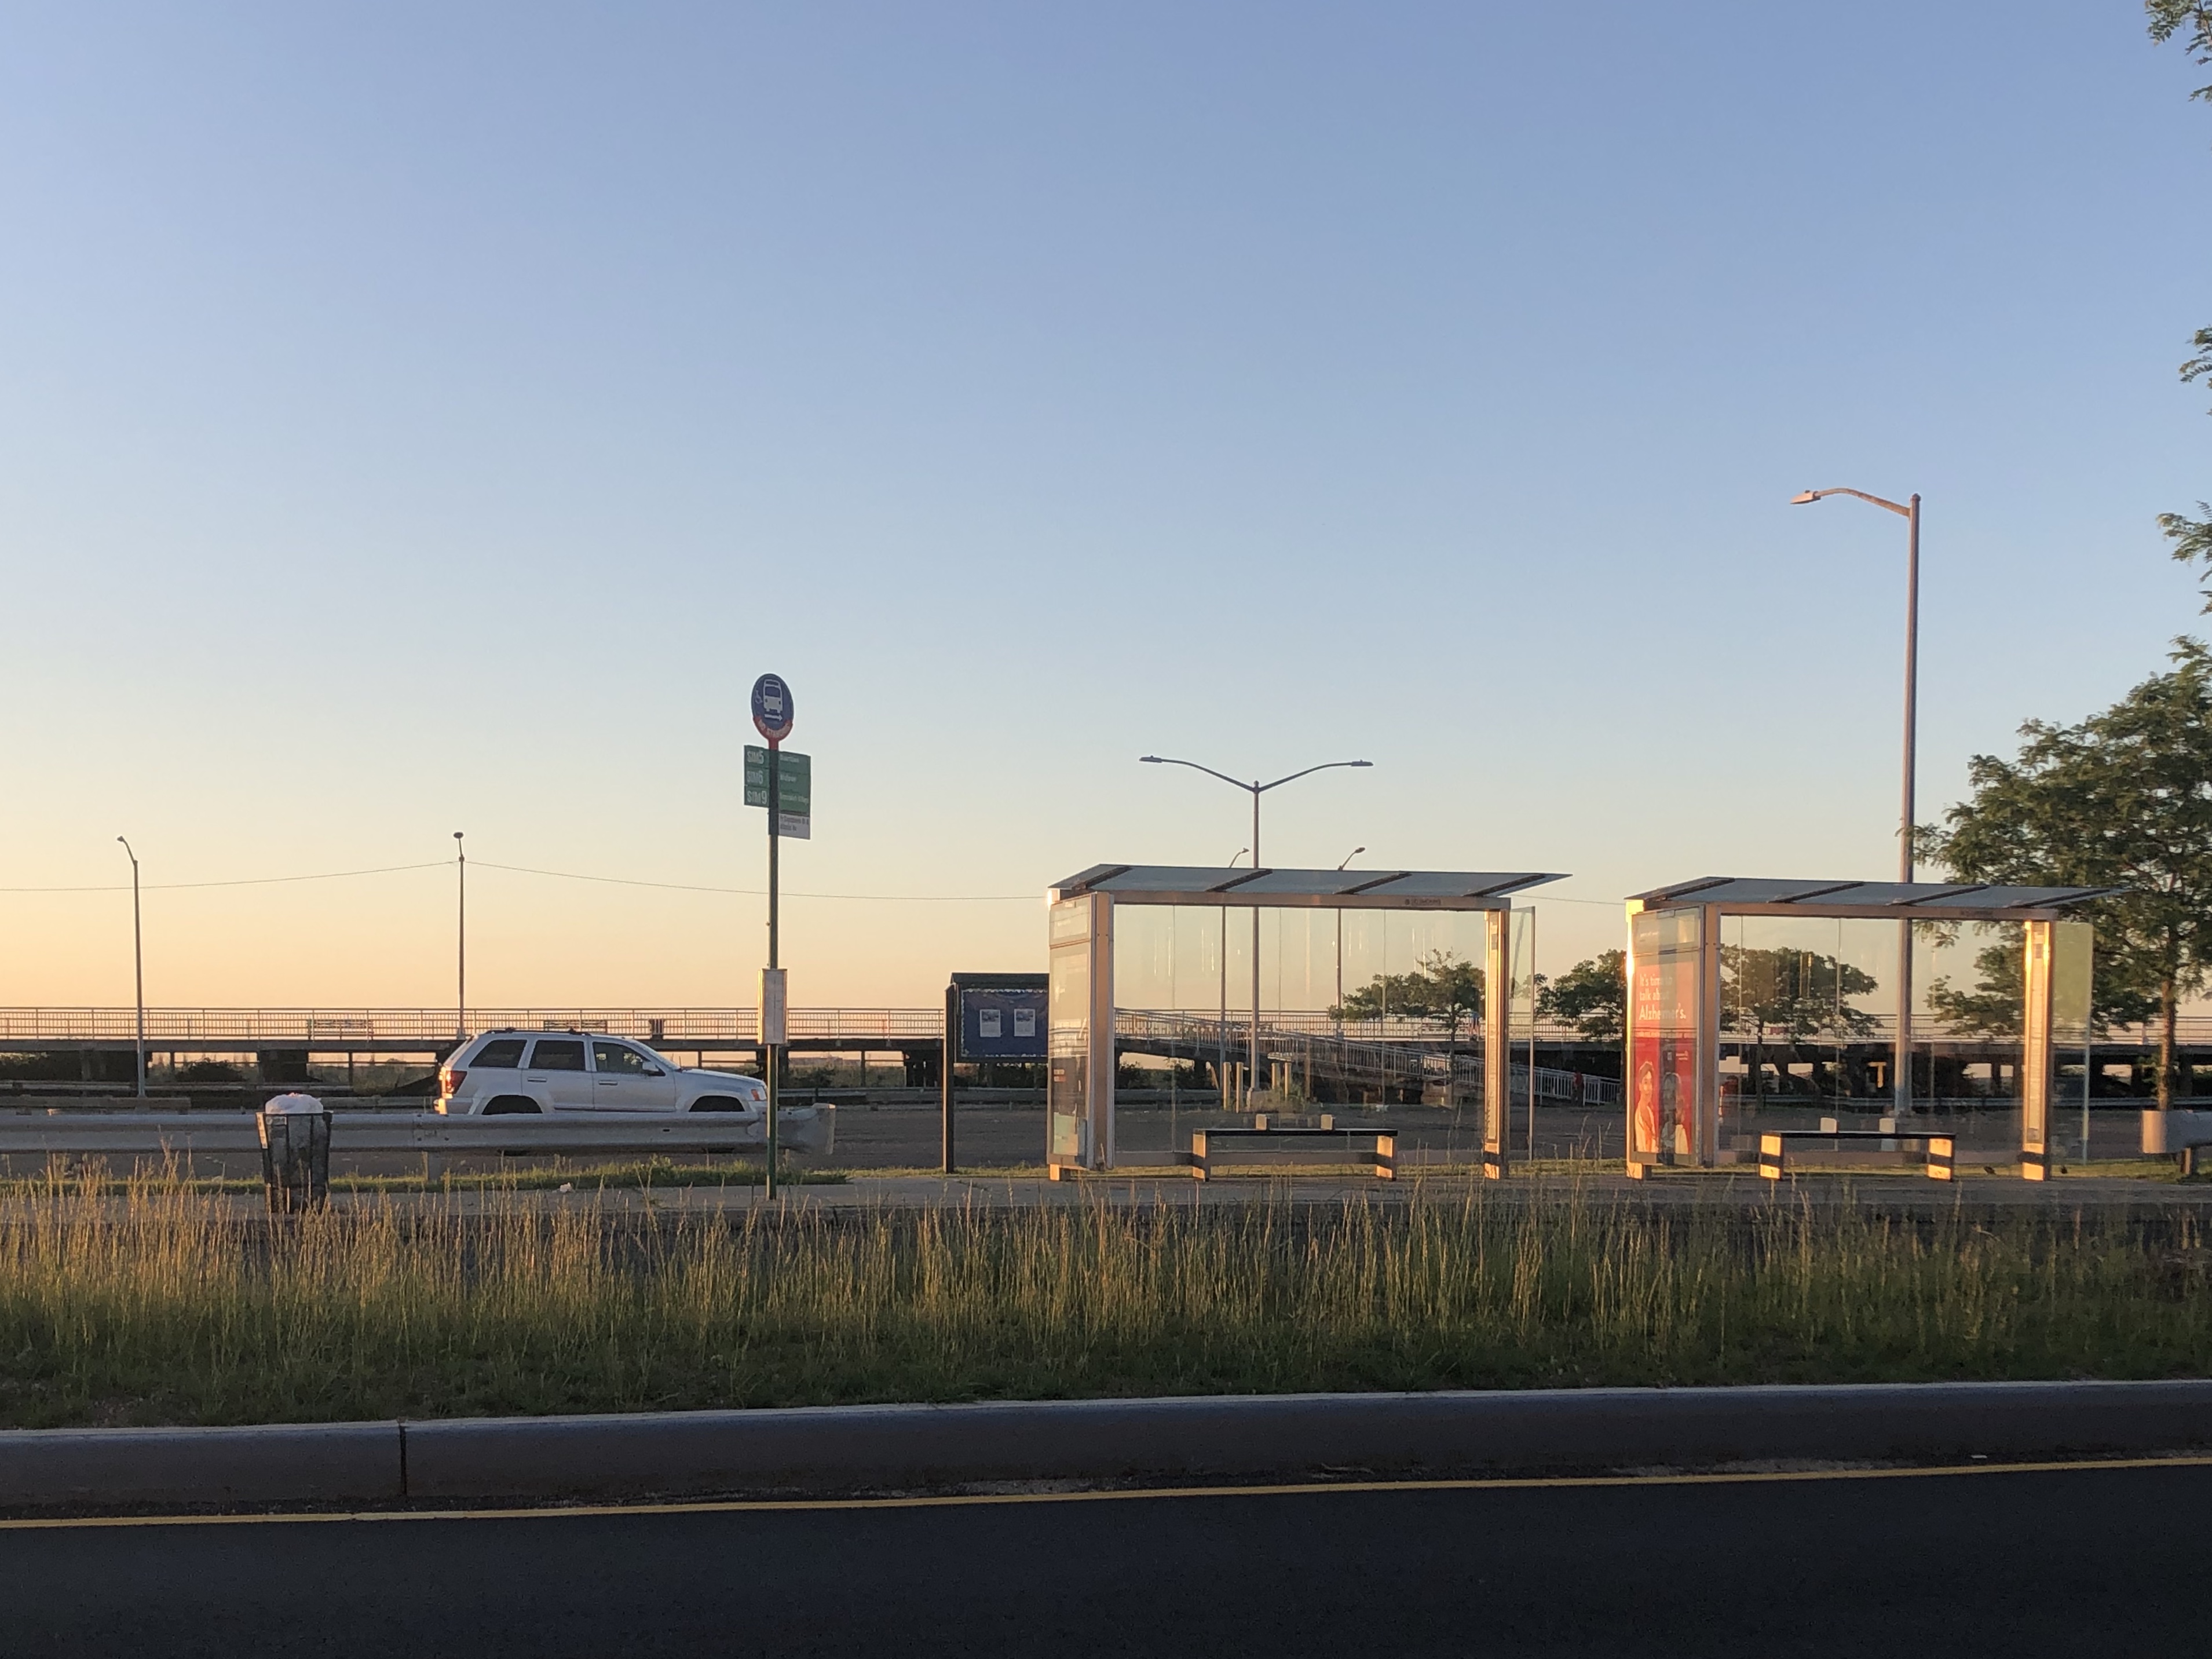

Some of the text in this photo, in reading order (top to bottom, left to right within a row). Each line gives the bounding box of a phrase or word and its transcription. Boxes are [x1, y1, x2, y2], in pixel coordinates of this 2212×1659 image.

[758, 719, 766, 731] NO
[747, 750, 764, 764] SIM5
[747, 770, 763, 784] SIM6
[747, 790, 767, 805] SIM9
[1640, 973, 1649, 986] It's
[1639, 988, 1651, 1002] talk
